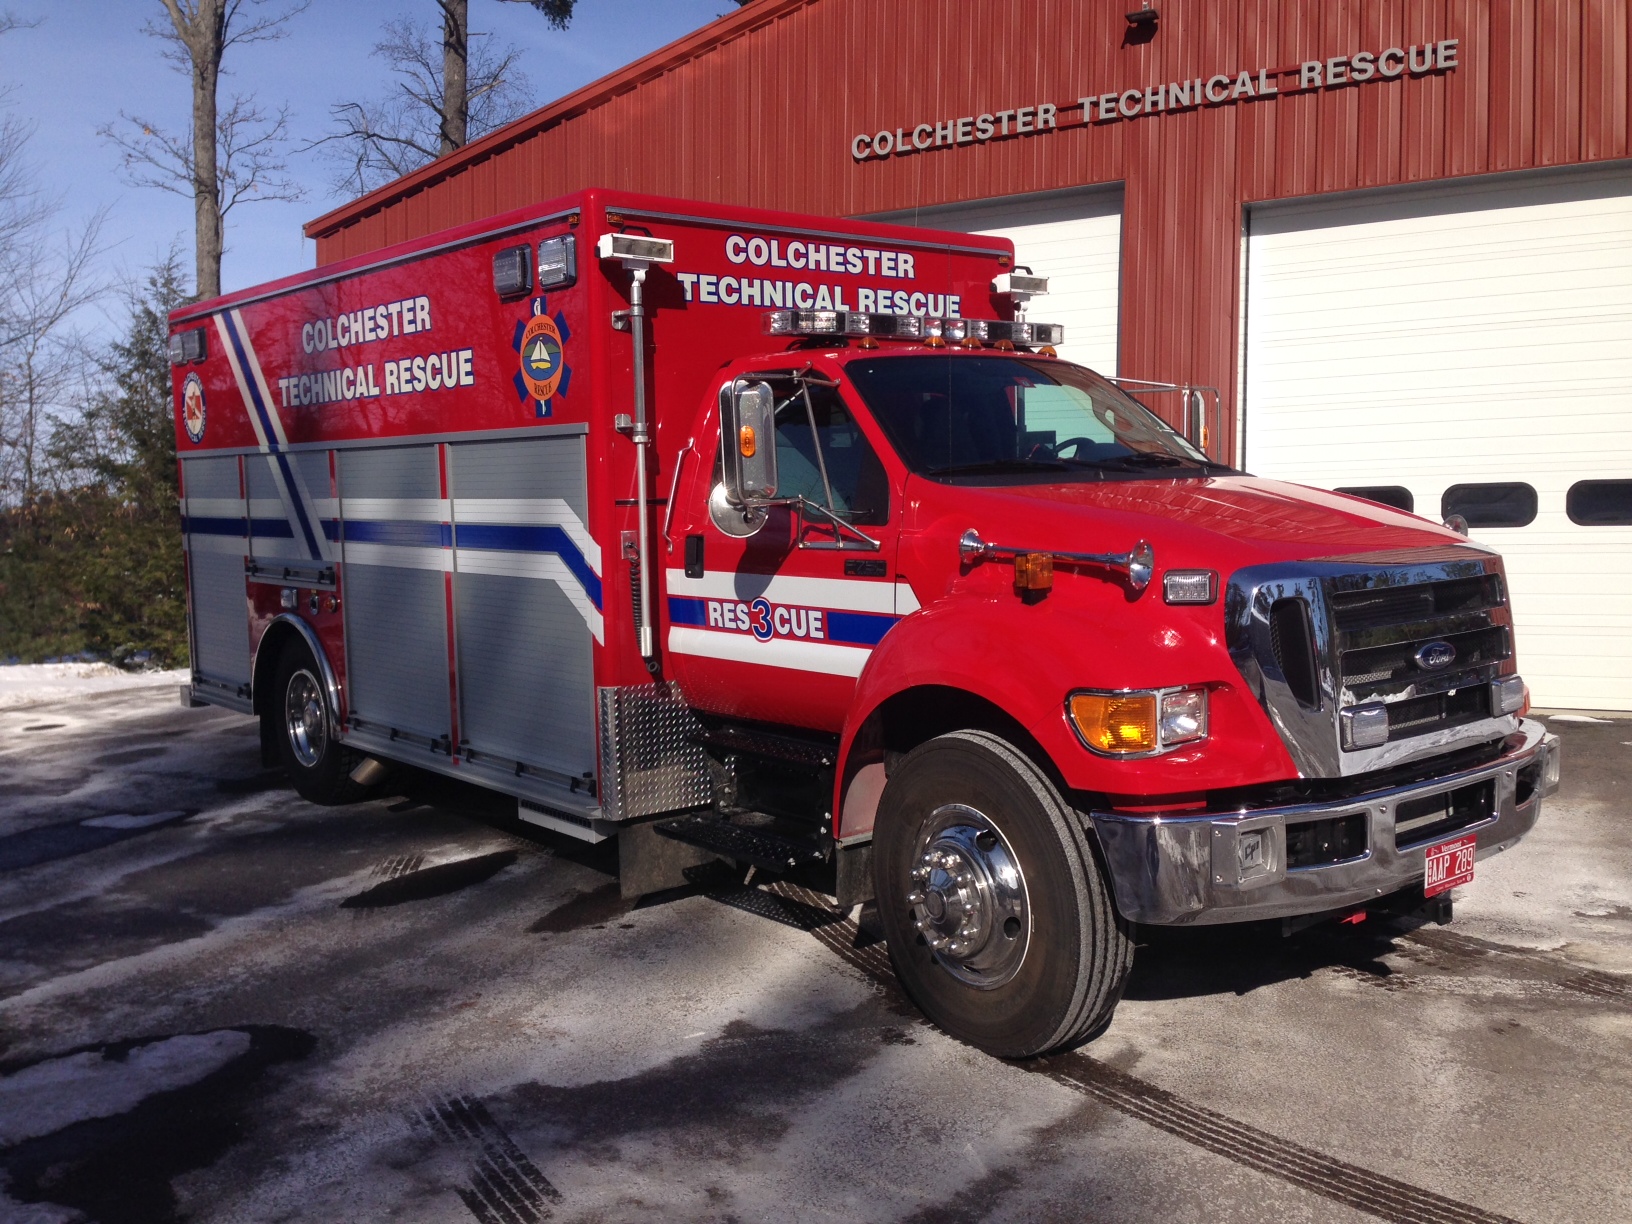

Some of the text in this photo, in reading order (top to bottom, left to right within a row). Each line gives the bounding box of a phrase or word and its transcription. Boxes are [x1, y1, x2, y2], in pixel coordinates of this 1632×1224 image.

[851, 38, 1460, 160] COLCHESTER TECHNICAL RESCUE
[725, 234, 916, 279] COLCHESTER
[677, 272, 961, 319] TECHNICAL RESCUE
[302, 295, 432, 354] COLCHESTER
[278, 347, 475, 407] TECHNICAL RESCUE
[533, 381, 553, 397] RESCUE
[1432, 854, 1451, 883] AAP
[1455, 847, 1474, 875] 289
